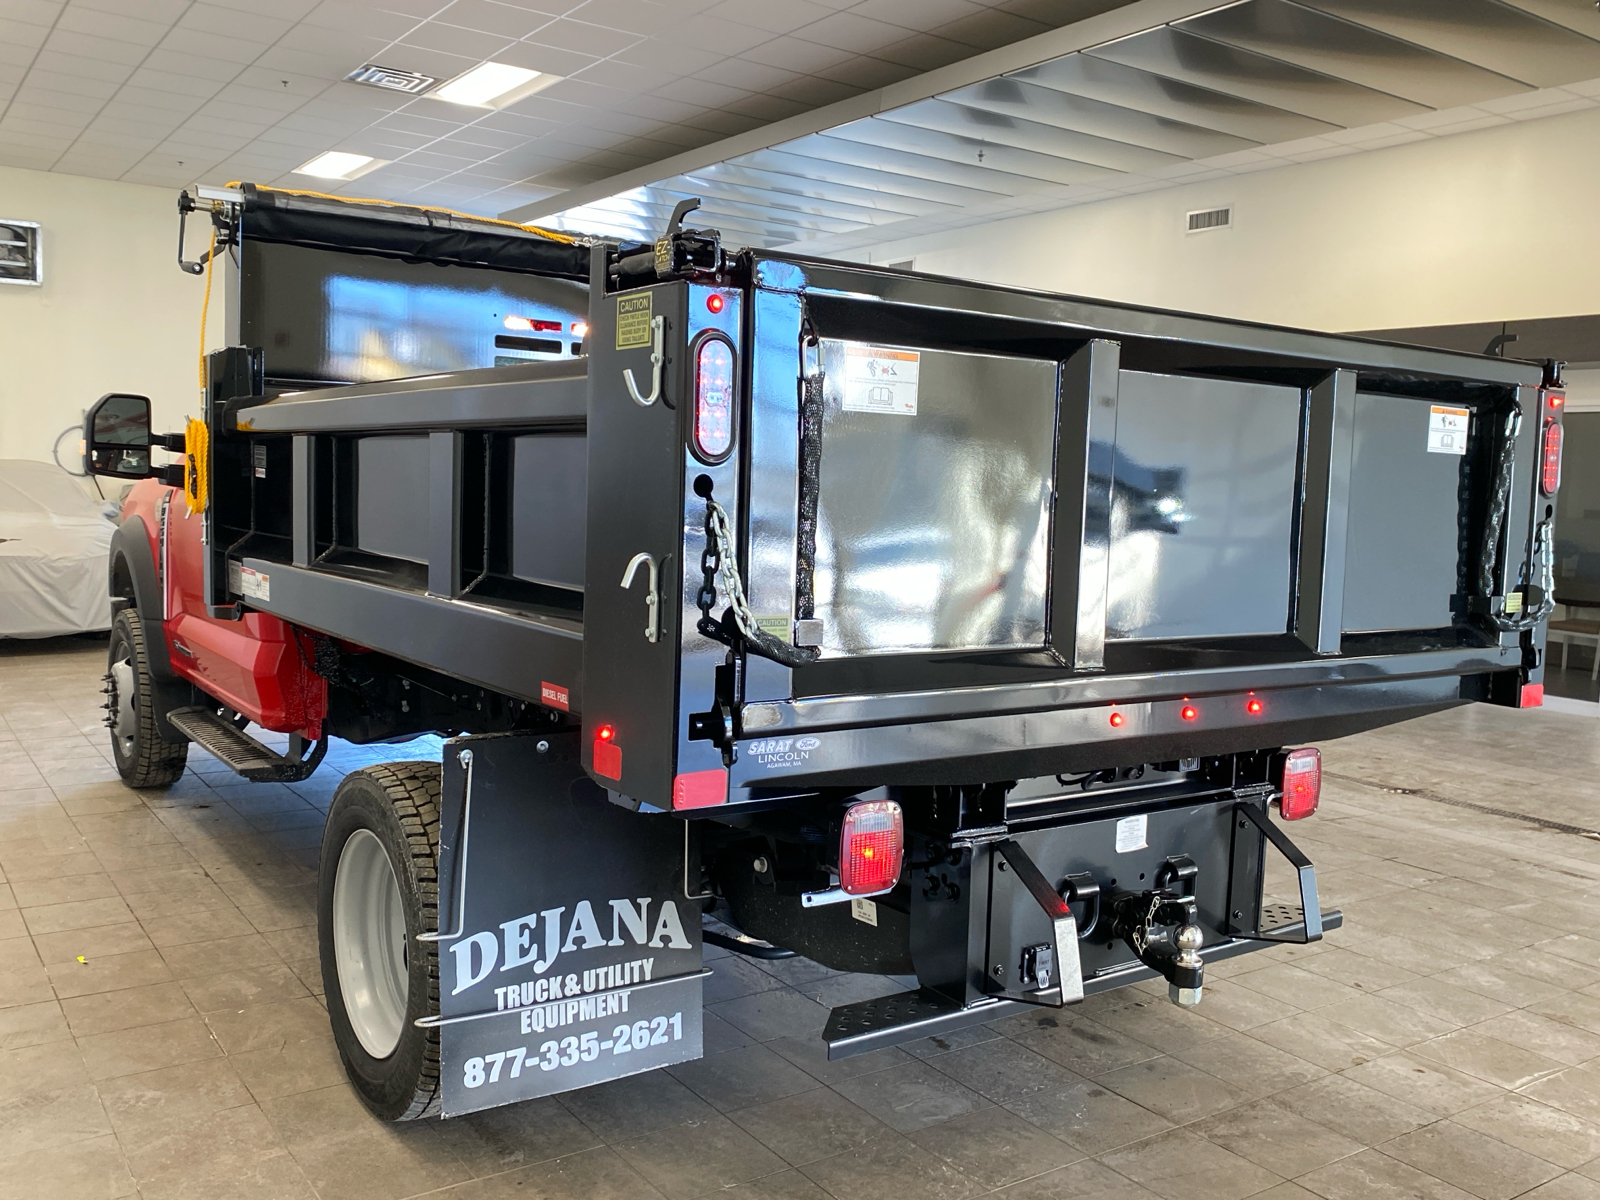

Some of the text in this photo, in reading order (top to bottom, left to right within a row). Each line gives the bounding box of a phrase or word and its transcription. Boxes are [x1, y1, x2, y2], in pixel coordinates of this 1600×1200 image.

[620, 297, 649, 312] CAUTION
[757, 619, 787, 627] CAUTION
[542, 687, 568, 704] DIESEL FUEL
[749, 739, 794, 754] SARAT
[758, 751, 809, 763] LINCOLN
[449, 897, 693, 996] DEJANA
[520, 990, 632, 1035] EQUIPMENT
[463, 1012, 683, 1089] 877-335-2621
